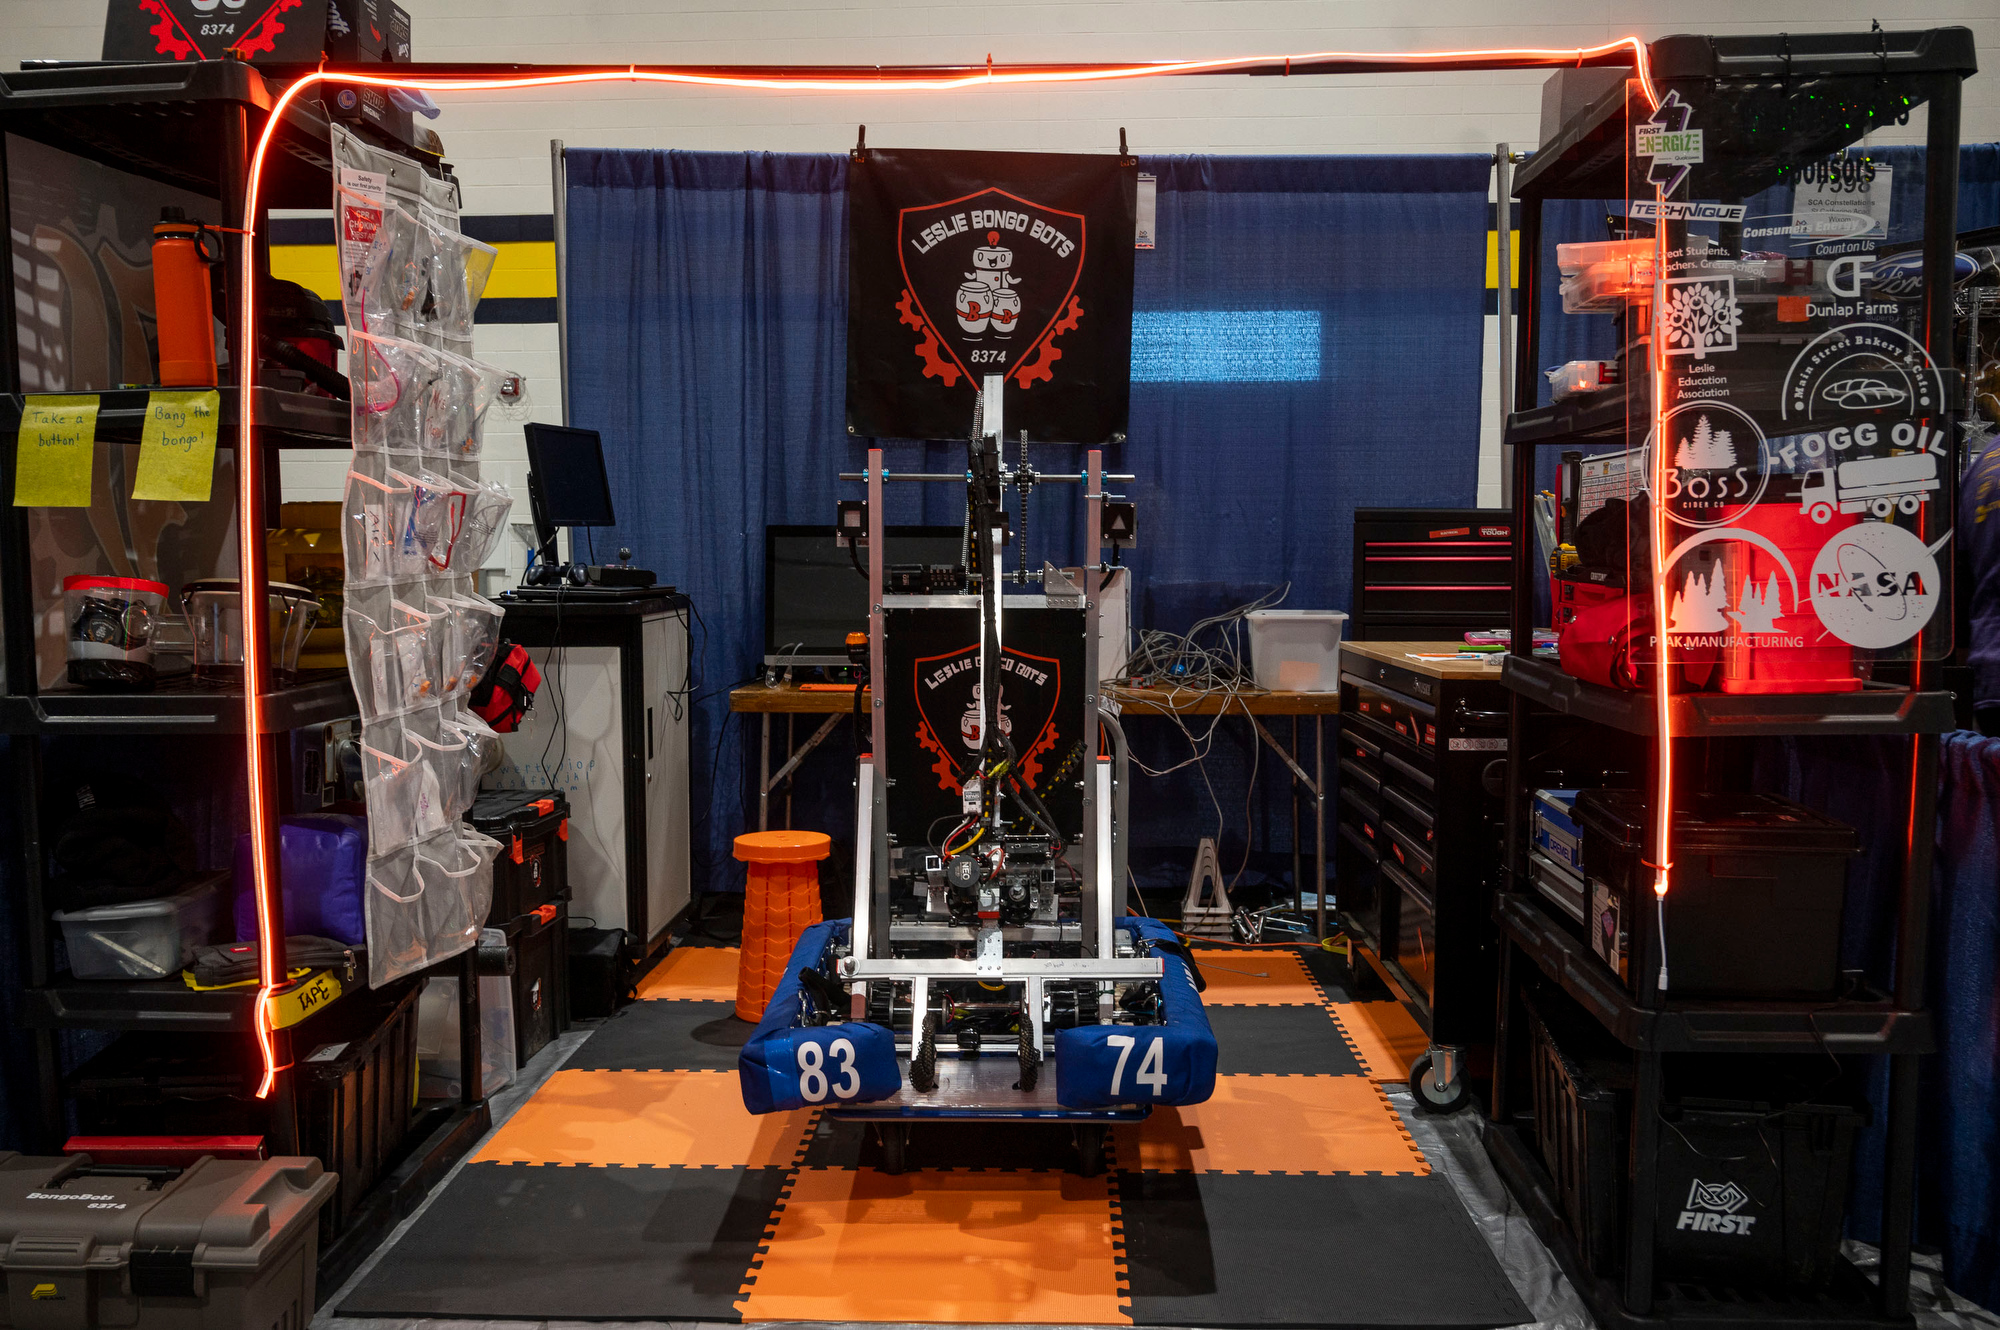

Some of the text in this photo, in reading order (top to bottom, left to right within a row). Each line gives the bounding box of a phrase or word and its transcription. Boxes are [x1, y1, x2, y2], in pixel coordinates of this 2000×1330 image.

[200, 23, 235, 37] 8374
[363, 87, 386, 109] SHOP
[1638, 127, 1661, 135] FIRST
[1638, 133, 1700, 153] ENERGIZE
[357, 174, 373, 184] Safety
[360, 182, 368, 190] first
[368, 184, 382, 192] priority
[1634, 203, 1742, 220] TECHNIQUE
[1828, 215, 1851, 223] Wixom
[911, 210, 1075, 258] LESLIE BONGO BOTS
[1743, 220, 1859, 238] Consumers Energy
[1656, 246, 1730, 260] Geat Students.
[1815, 240, 1875, 255] Count on Us
[1656, 259, 1767, 278] eachers. Great Schools.
[1805, 302, 1898, 317] Dunlap Farms
[970, 349, 1007, 363] 8374
[1688, 363, 1715, 373] Leslie
[1794, 335, 1928, 399] Main Street Bakery & Cafe
[1678, 376, 1727, 387] Education
[1677, 388, 1730, 399] Association
[32, 411, 84, 424] Take a
[155, 405, 211, 428] Bang the
[38, 433, 80, 447] button!
[162, 431, 204, 453] bongo!
[1779, 423, 1947, 469] FOGG OIL
[1683, 501, 1709, 509] CIDER
[369, 511, 381, 562] Alex
[1816, 571, 1929, 597] NASA
[1650, 636, 1804, 648] PAK MANUFACTURING
[924, 658, 973, 690] LESLIE
[1015, 662, 1049, 687] BOTS
[1550, 838, 1571, 862] DREMEL
[960, 862, 971, 880] NEO
[297, 978, 331, 1012] TAPE
[797, 1038, 861, 1103] 83
[1106, 1035, 1168, 1096] 74
[26, 1192, 115, 1202] BongoBots
[87, 1202, 127, 1210] 8374
[1676, 1211, 1756, 1236] FIRST
